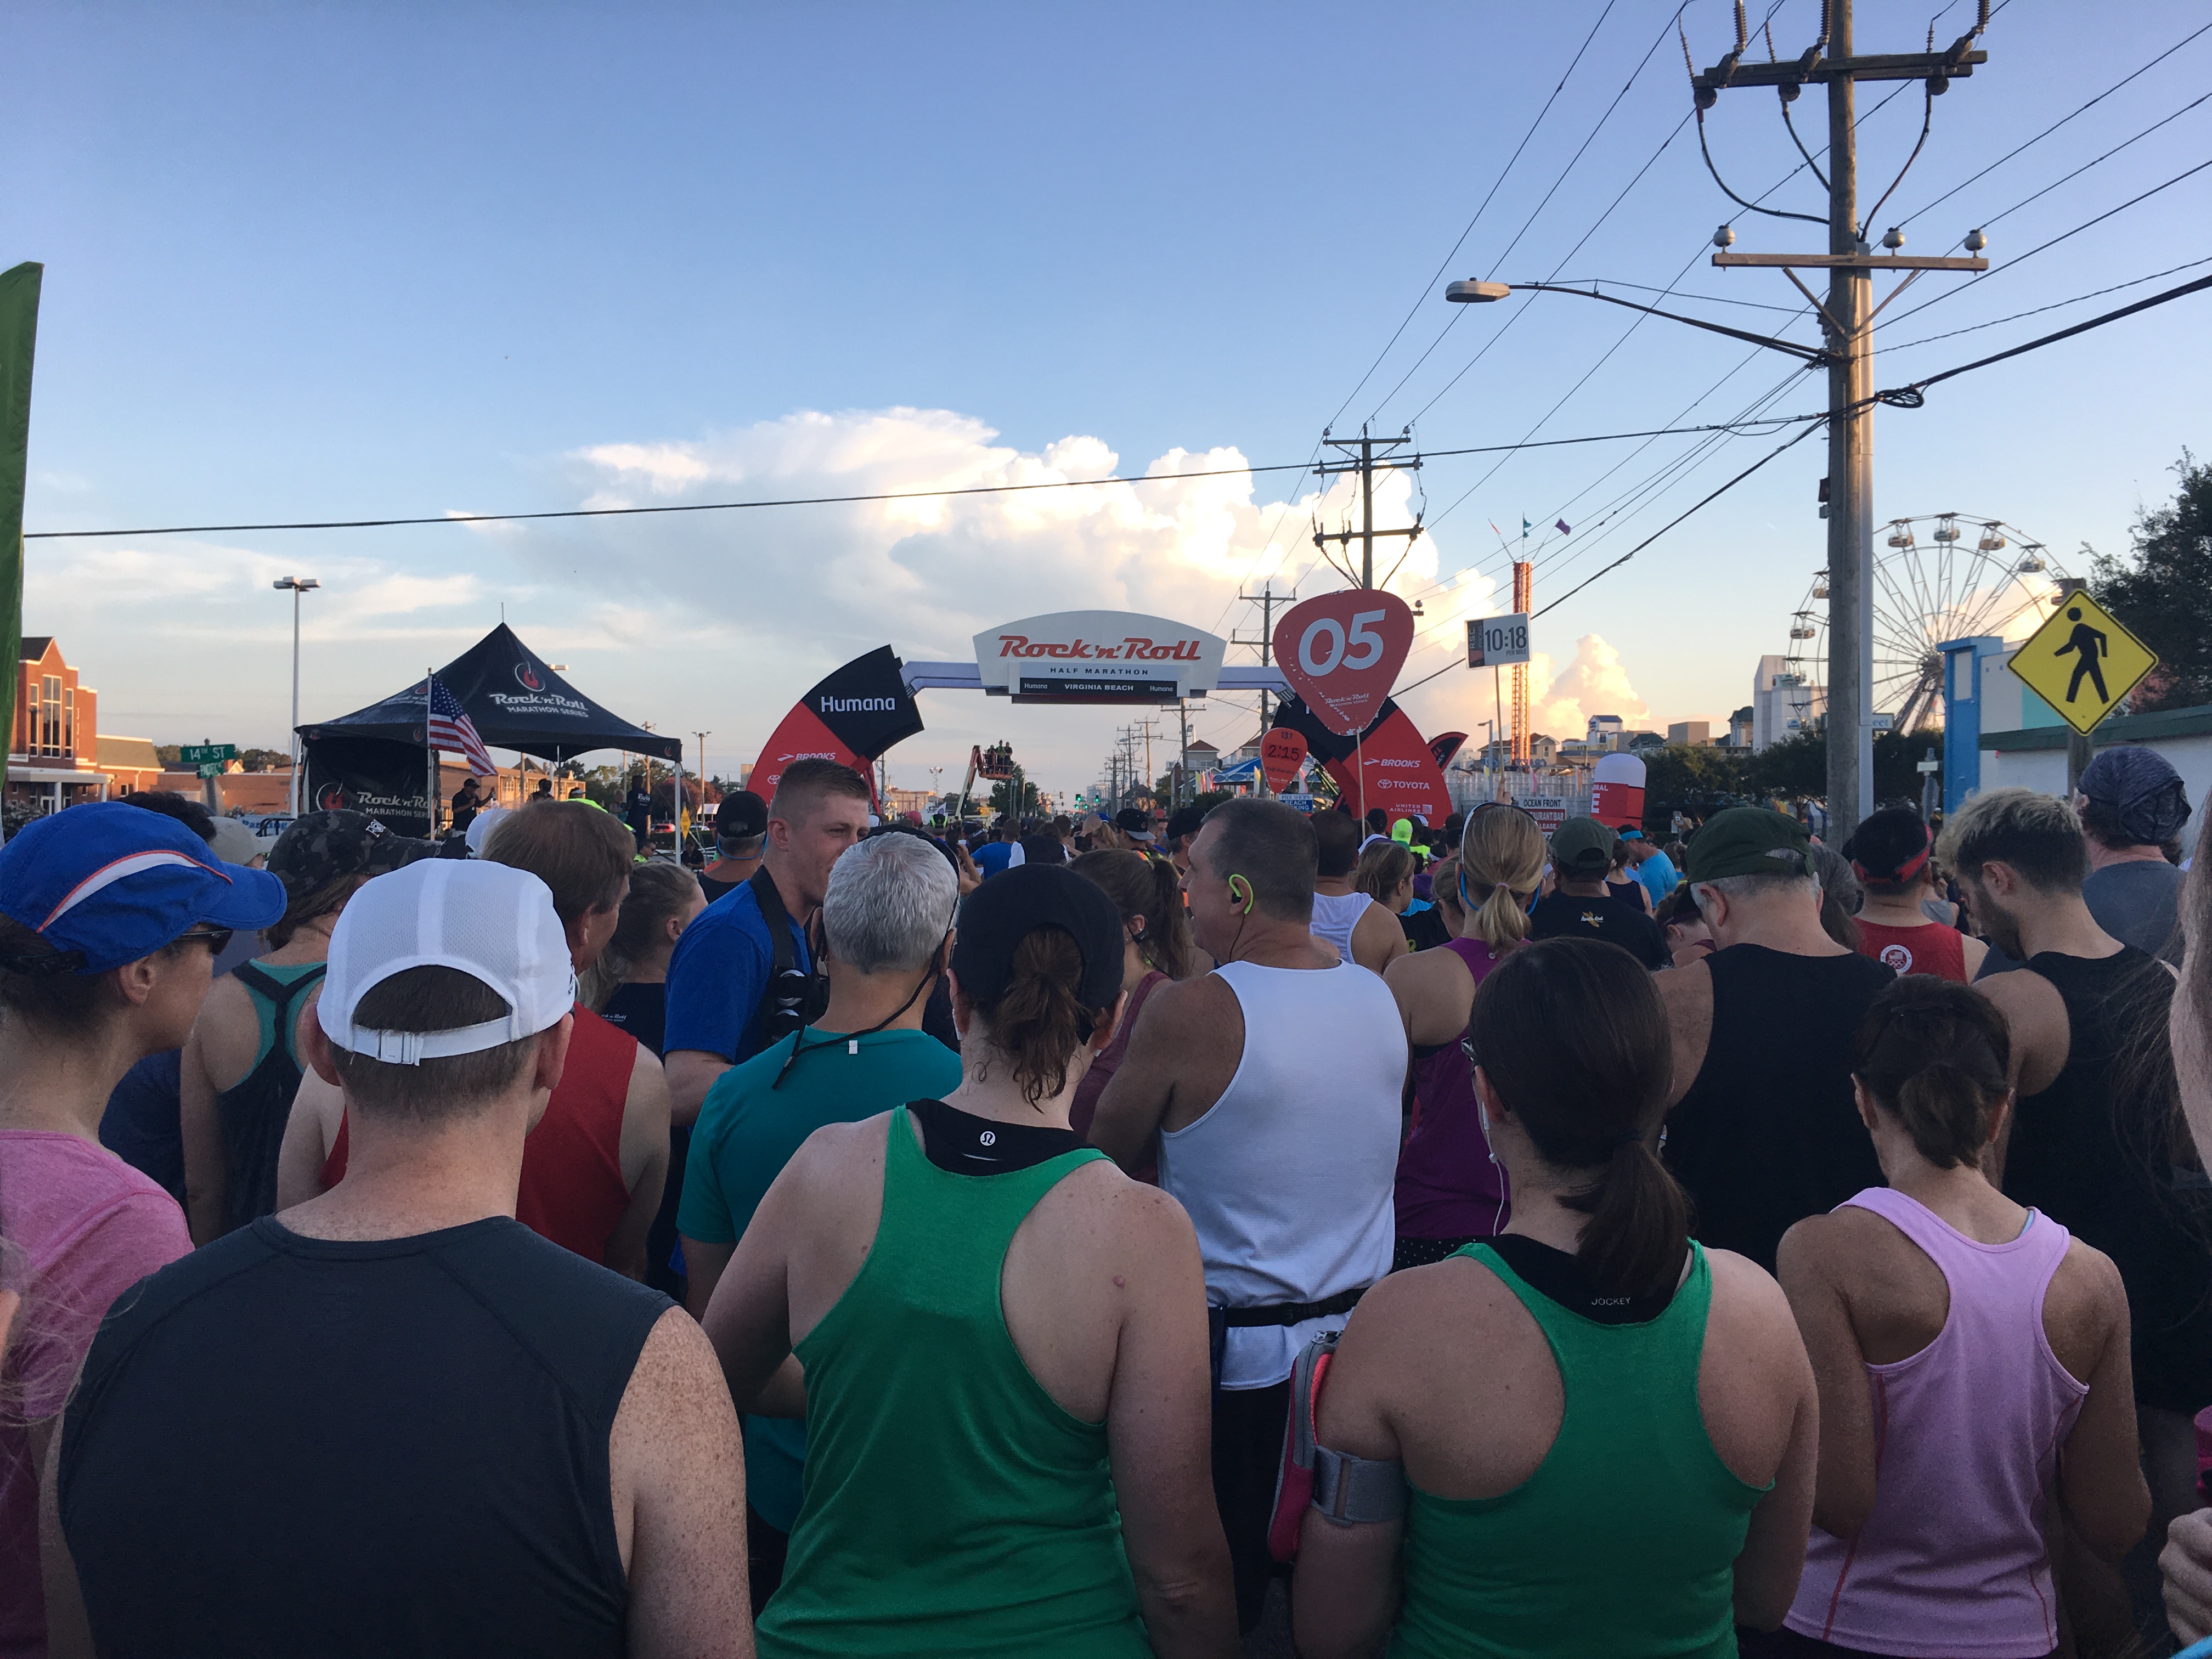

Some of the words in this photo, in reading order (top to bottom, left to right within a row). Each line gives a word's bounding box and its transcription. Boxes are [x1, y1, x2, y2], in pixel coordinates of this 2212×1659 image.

[1298, 609, 1386, 677] 05
[1485, 625, 1527, 652] 10:18
[821, 696, 896, 712] Humana
[560, 708, 589, 718] SERIES
[212, 746, 225, 759] ST
[1267, 744, 1300, 761] 2:15
[1380, 759, 1421, 768] BROOKS
[1393, 781, 1430, 790] TOYOTA
[1523, 799, 1542, 808] OCEAN
[1543, 799, 1561, 808] FRONT
[365, 806, 412, 816] MARATHON
[1553, 812, 1564, 821] BAR
[1591, 1297, 1630, 1306] JOCKEY
